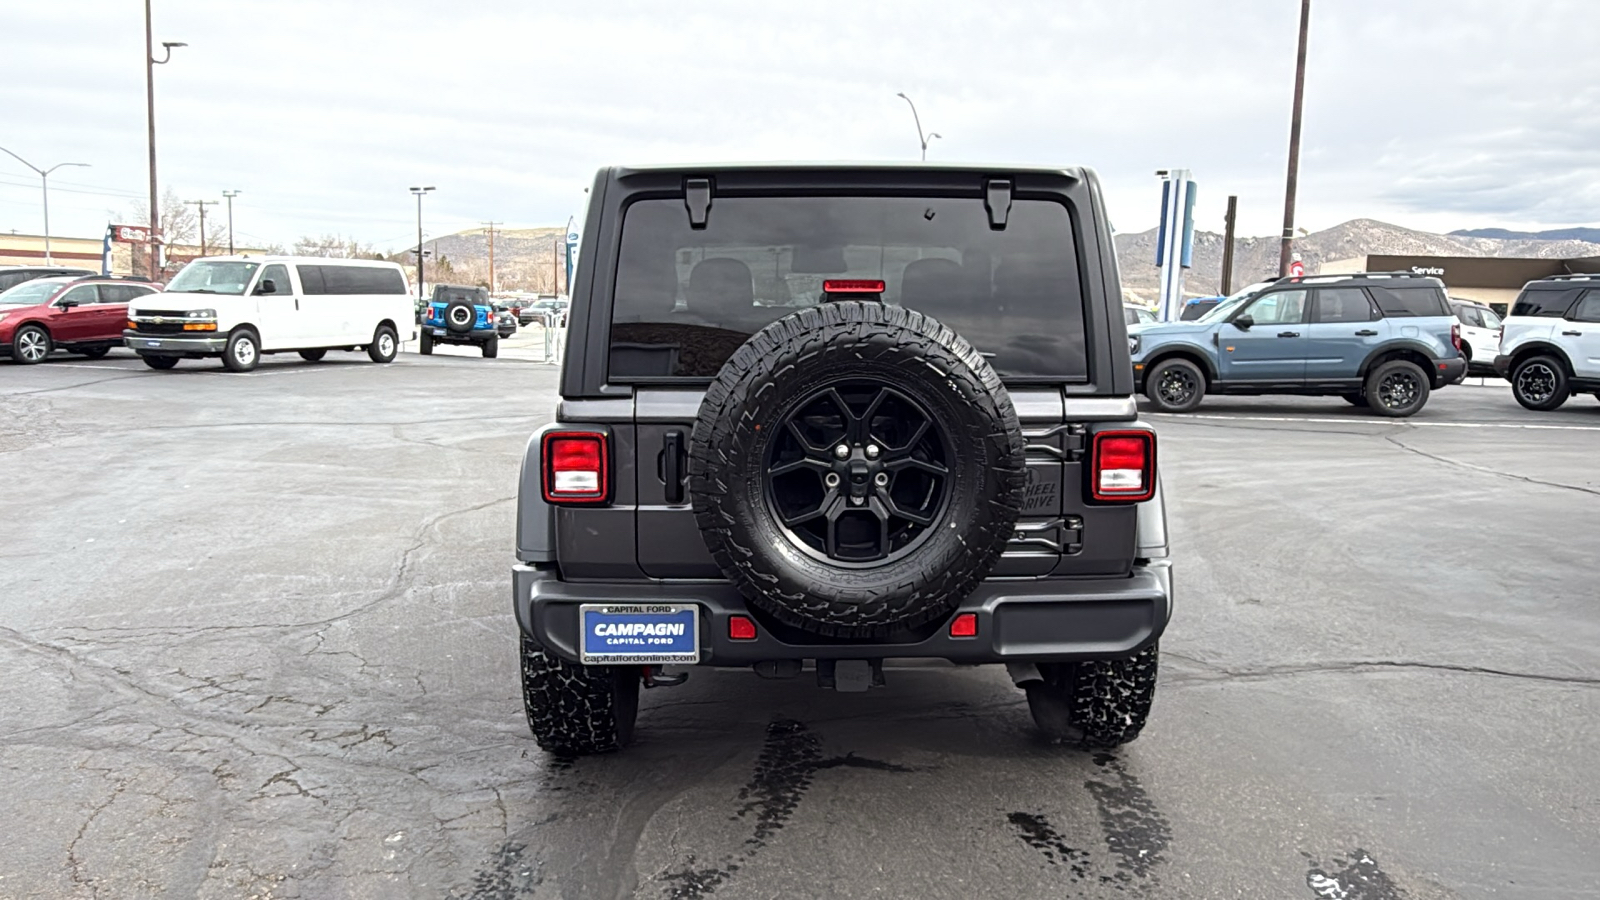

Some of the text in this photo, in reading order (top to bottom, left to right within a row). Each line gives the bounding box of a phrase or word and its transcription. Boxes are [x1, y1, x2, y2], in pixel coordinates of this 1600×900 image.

[1411, 265, 1445, 275] Service
[1024, 482, 1056, 498] HEEL
[607, 605, 672, 613] CAPITAL FORD
[594, 623, 685, 637] CAMPAGNI
[584, 654, 697, 663] capitalfordonline.com
